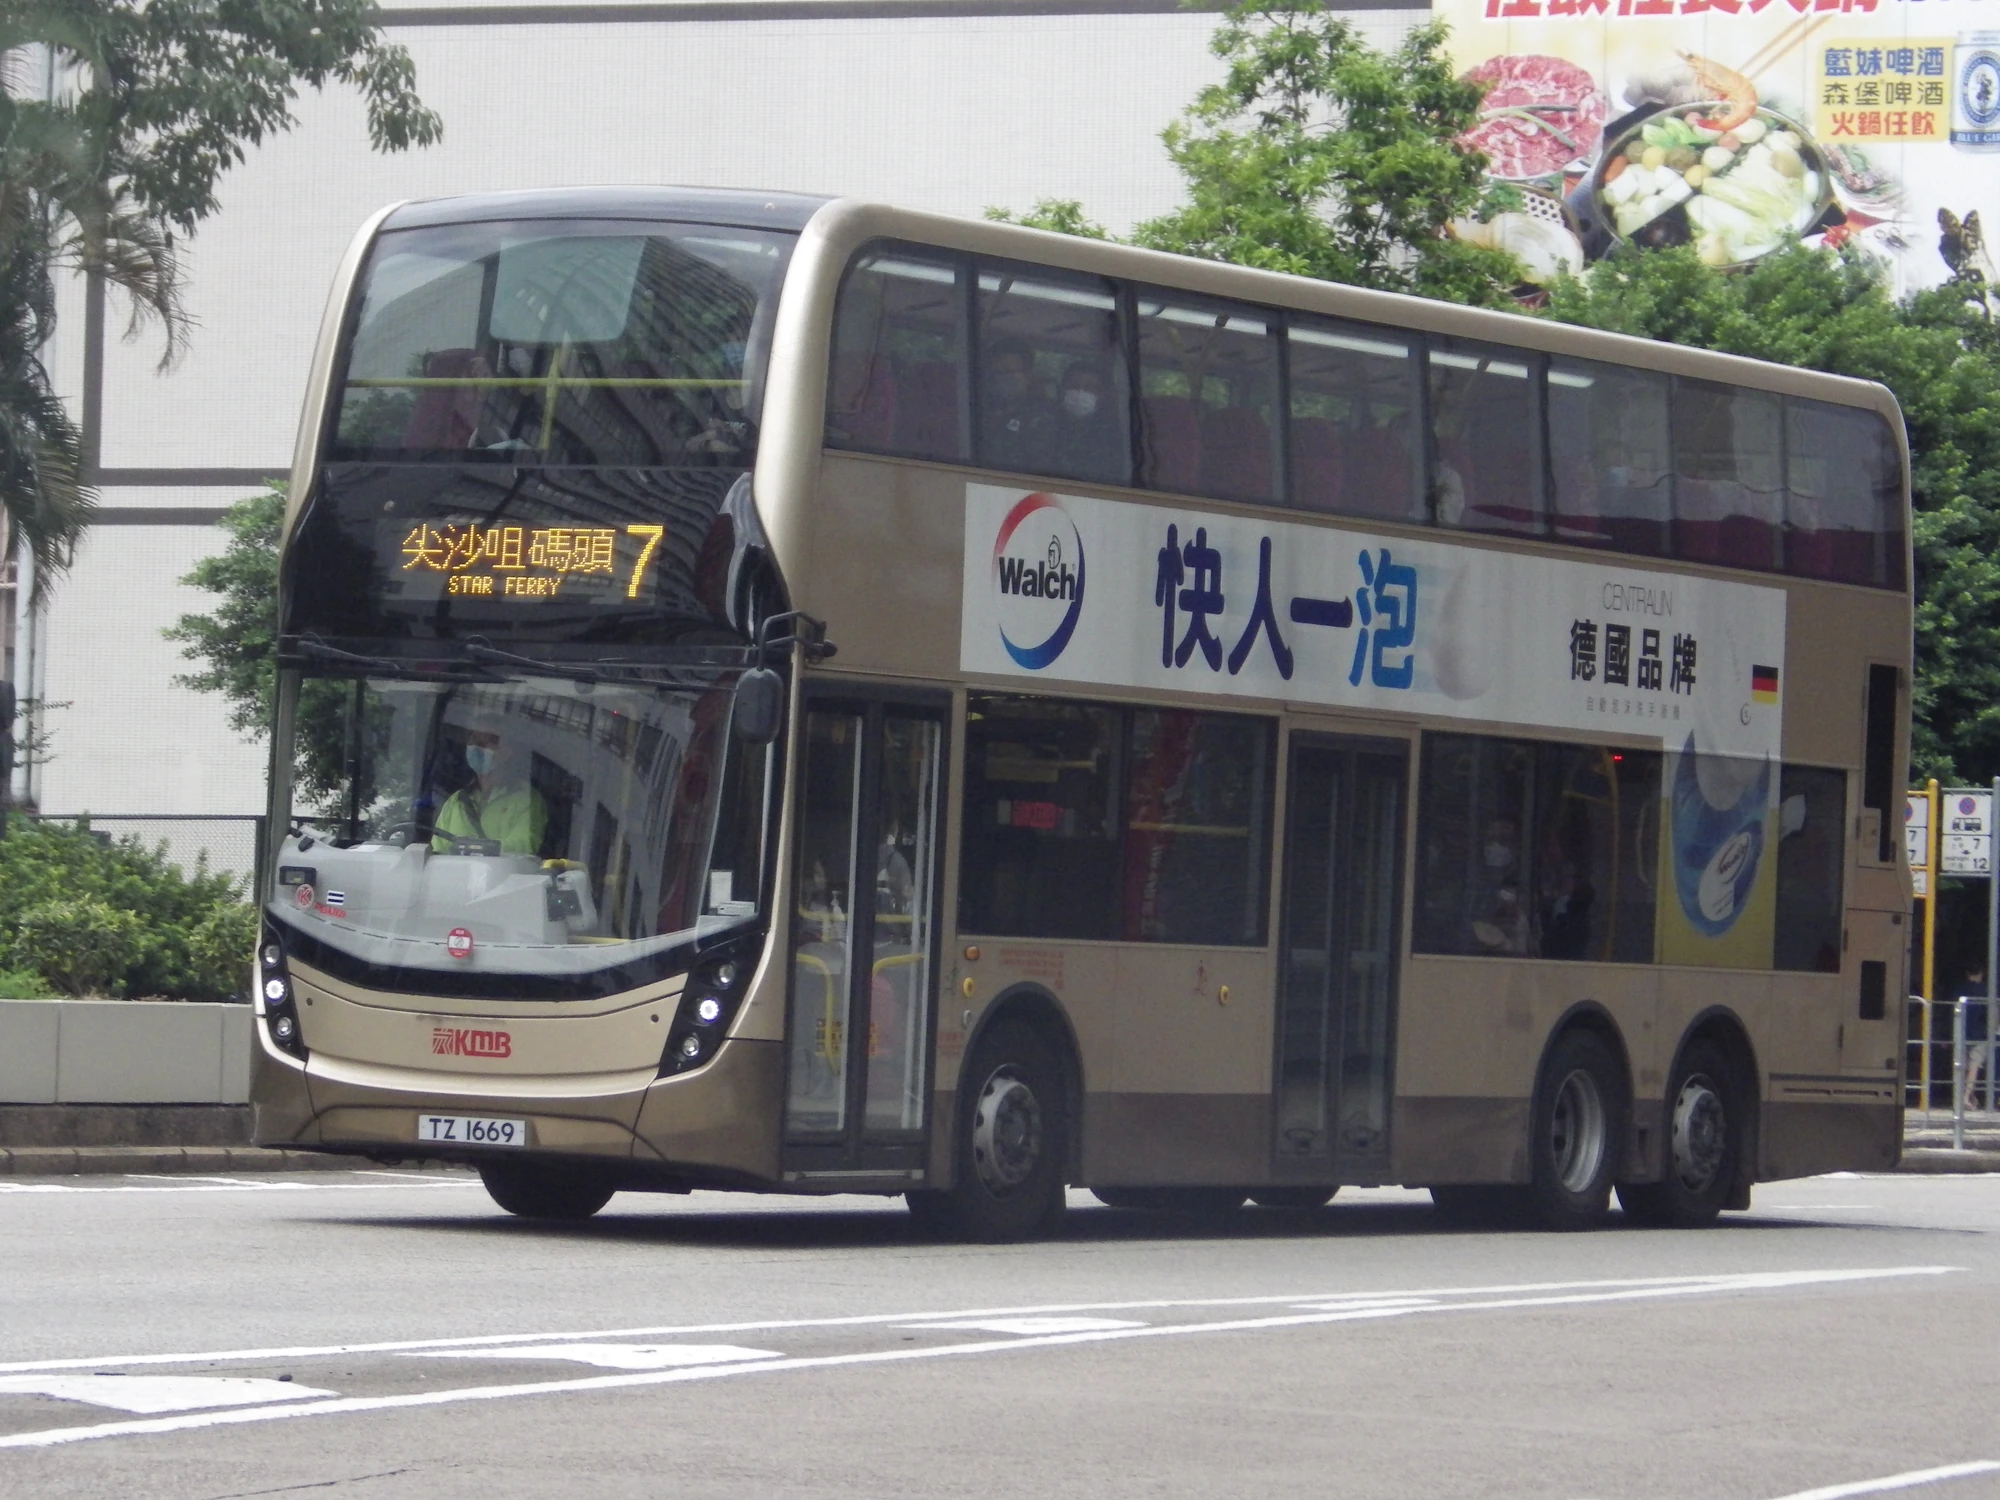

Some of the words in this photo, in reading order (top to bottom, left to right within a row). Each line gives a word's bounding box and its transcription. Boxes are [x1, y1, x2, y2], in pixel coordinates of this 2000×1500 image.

[1823, 47, 1945, 77] 藍妹啤酒
[1822, 81, 1944, 106] 森堡啤酒
[1831, 110, 1935, 136] 火鍋任飲
[401, 523, 617, 573] 尖沙咀碼頭
[627, 525, 664, 598] 7
[448, 575, 493, 595] STAR
[504, 576, 561, 596] FERRY
[999, 555, 1076, 601] Walch
[1154, 522, 1418, 690] 快人一泡
[1569, 618, 1698, 696] 德國品牌
[454, 1028, 512, 1059] KMB
[428, 1117, 457, 1140] TZ
[466, 1120, 515, 1143] 1669
